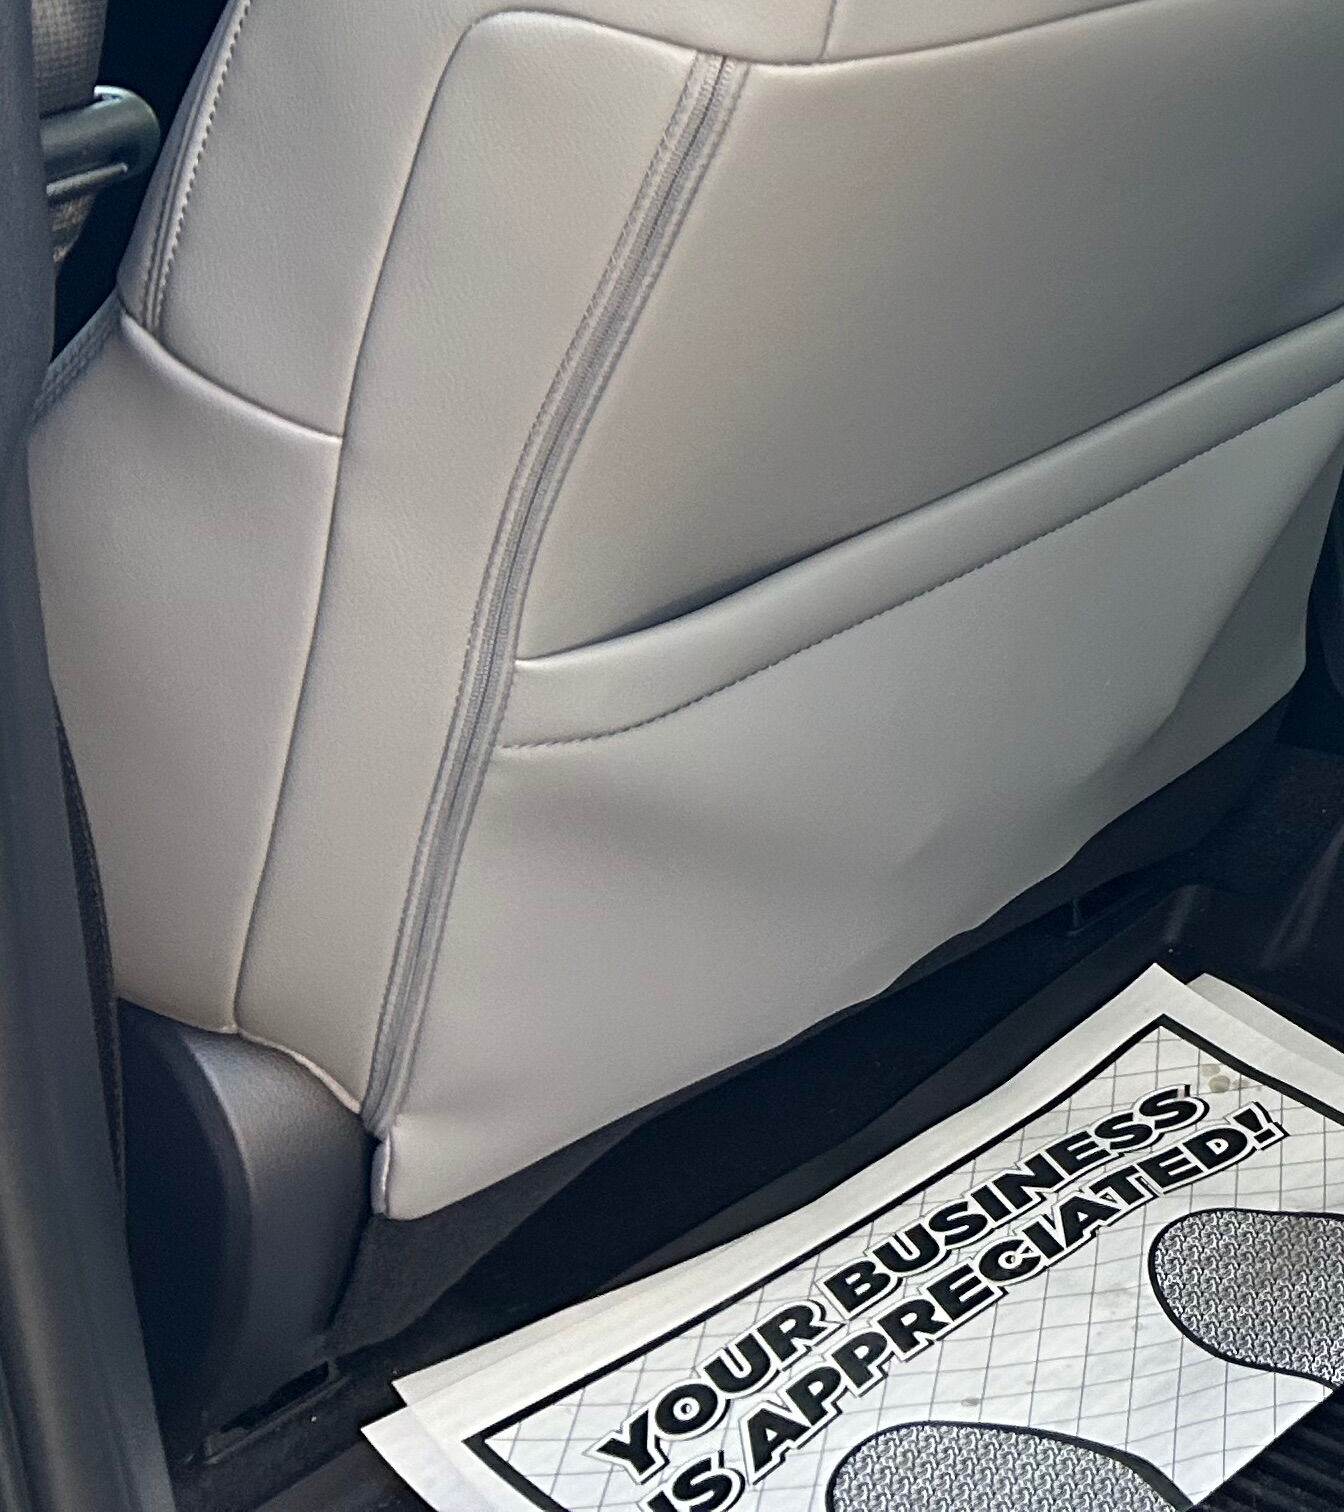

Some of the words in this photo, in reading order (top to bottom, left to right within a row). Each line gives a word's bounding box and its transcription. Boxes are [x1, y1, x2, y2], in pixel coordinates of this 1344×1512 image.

[584, 1297, 844, 1484] YOUR
[817, 1085, 1210, 1325] BUSINESS
[745, 1101, 1290, 1486] APPRECIATED!
